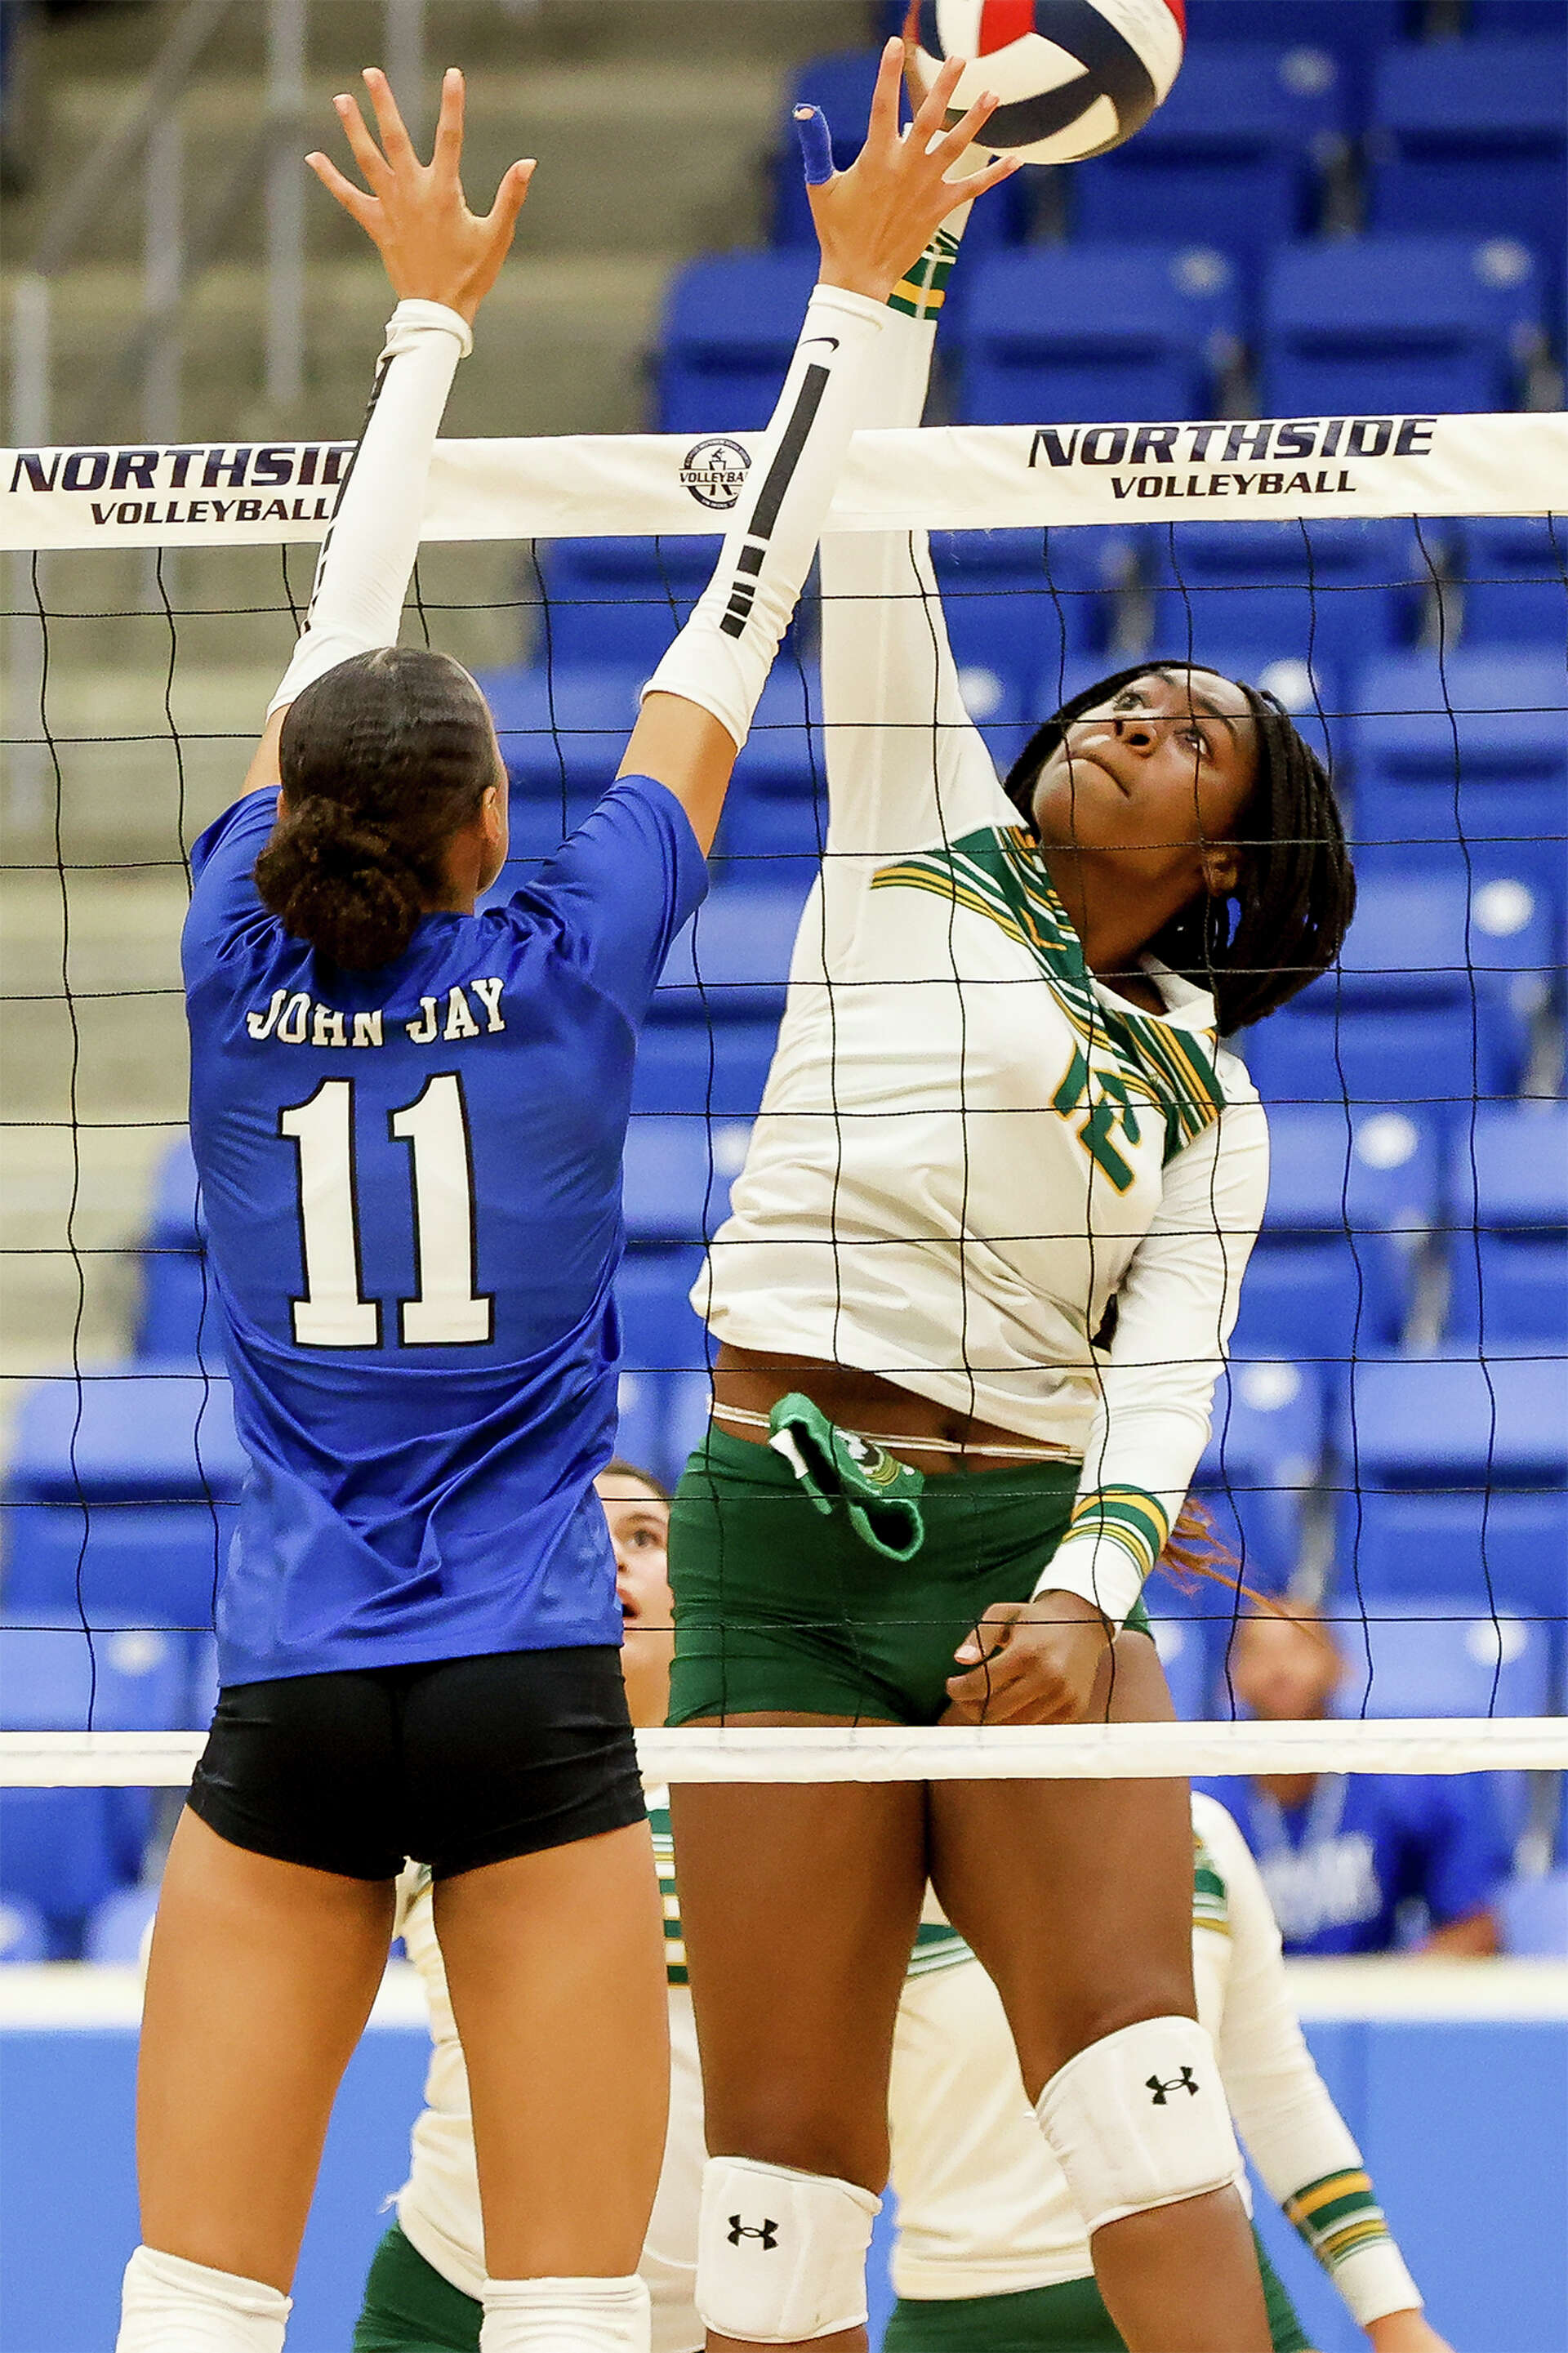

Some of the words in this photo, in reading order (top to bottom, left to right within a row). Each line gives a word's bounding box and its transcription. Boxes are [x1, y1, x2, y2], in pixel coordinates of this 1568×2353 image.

[1027, 418, 1437, 468] NORTHSIDE
[8, 446, 360, 492] NORTHSID
[679, 470, 748, 483] VOLLEYBA
[1111, 470, 1356, 499] VOLLEYBALL
[90, 498, 329, 525] VOLLEYBALL
[247, 988, 384, 1048] JOHN
[406, 977, 506, 1045] JAY
[277, 1069, 496, 1349] 11
